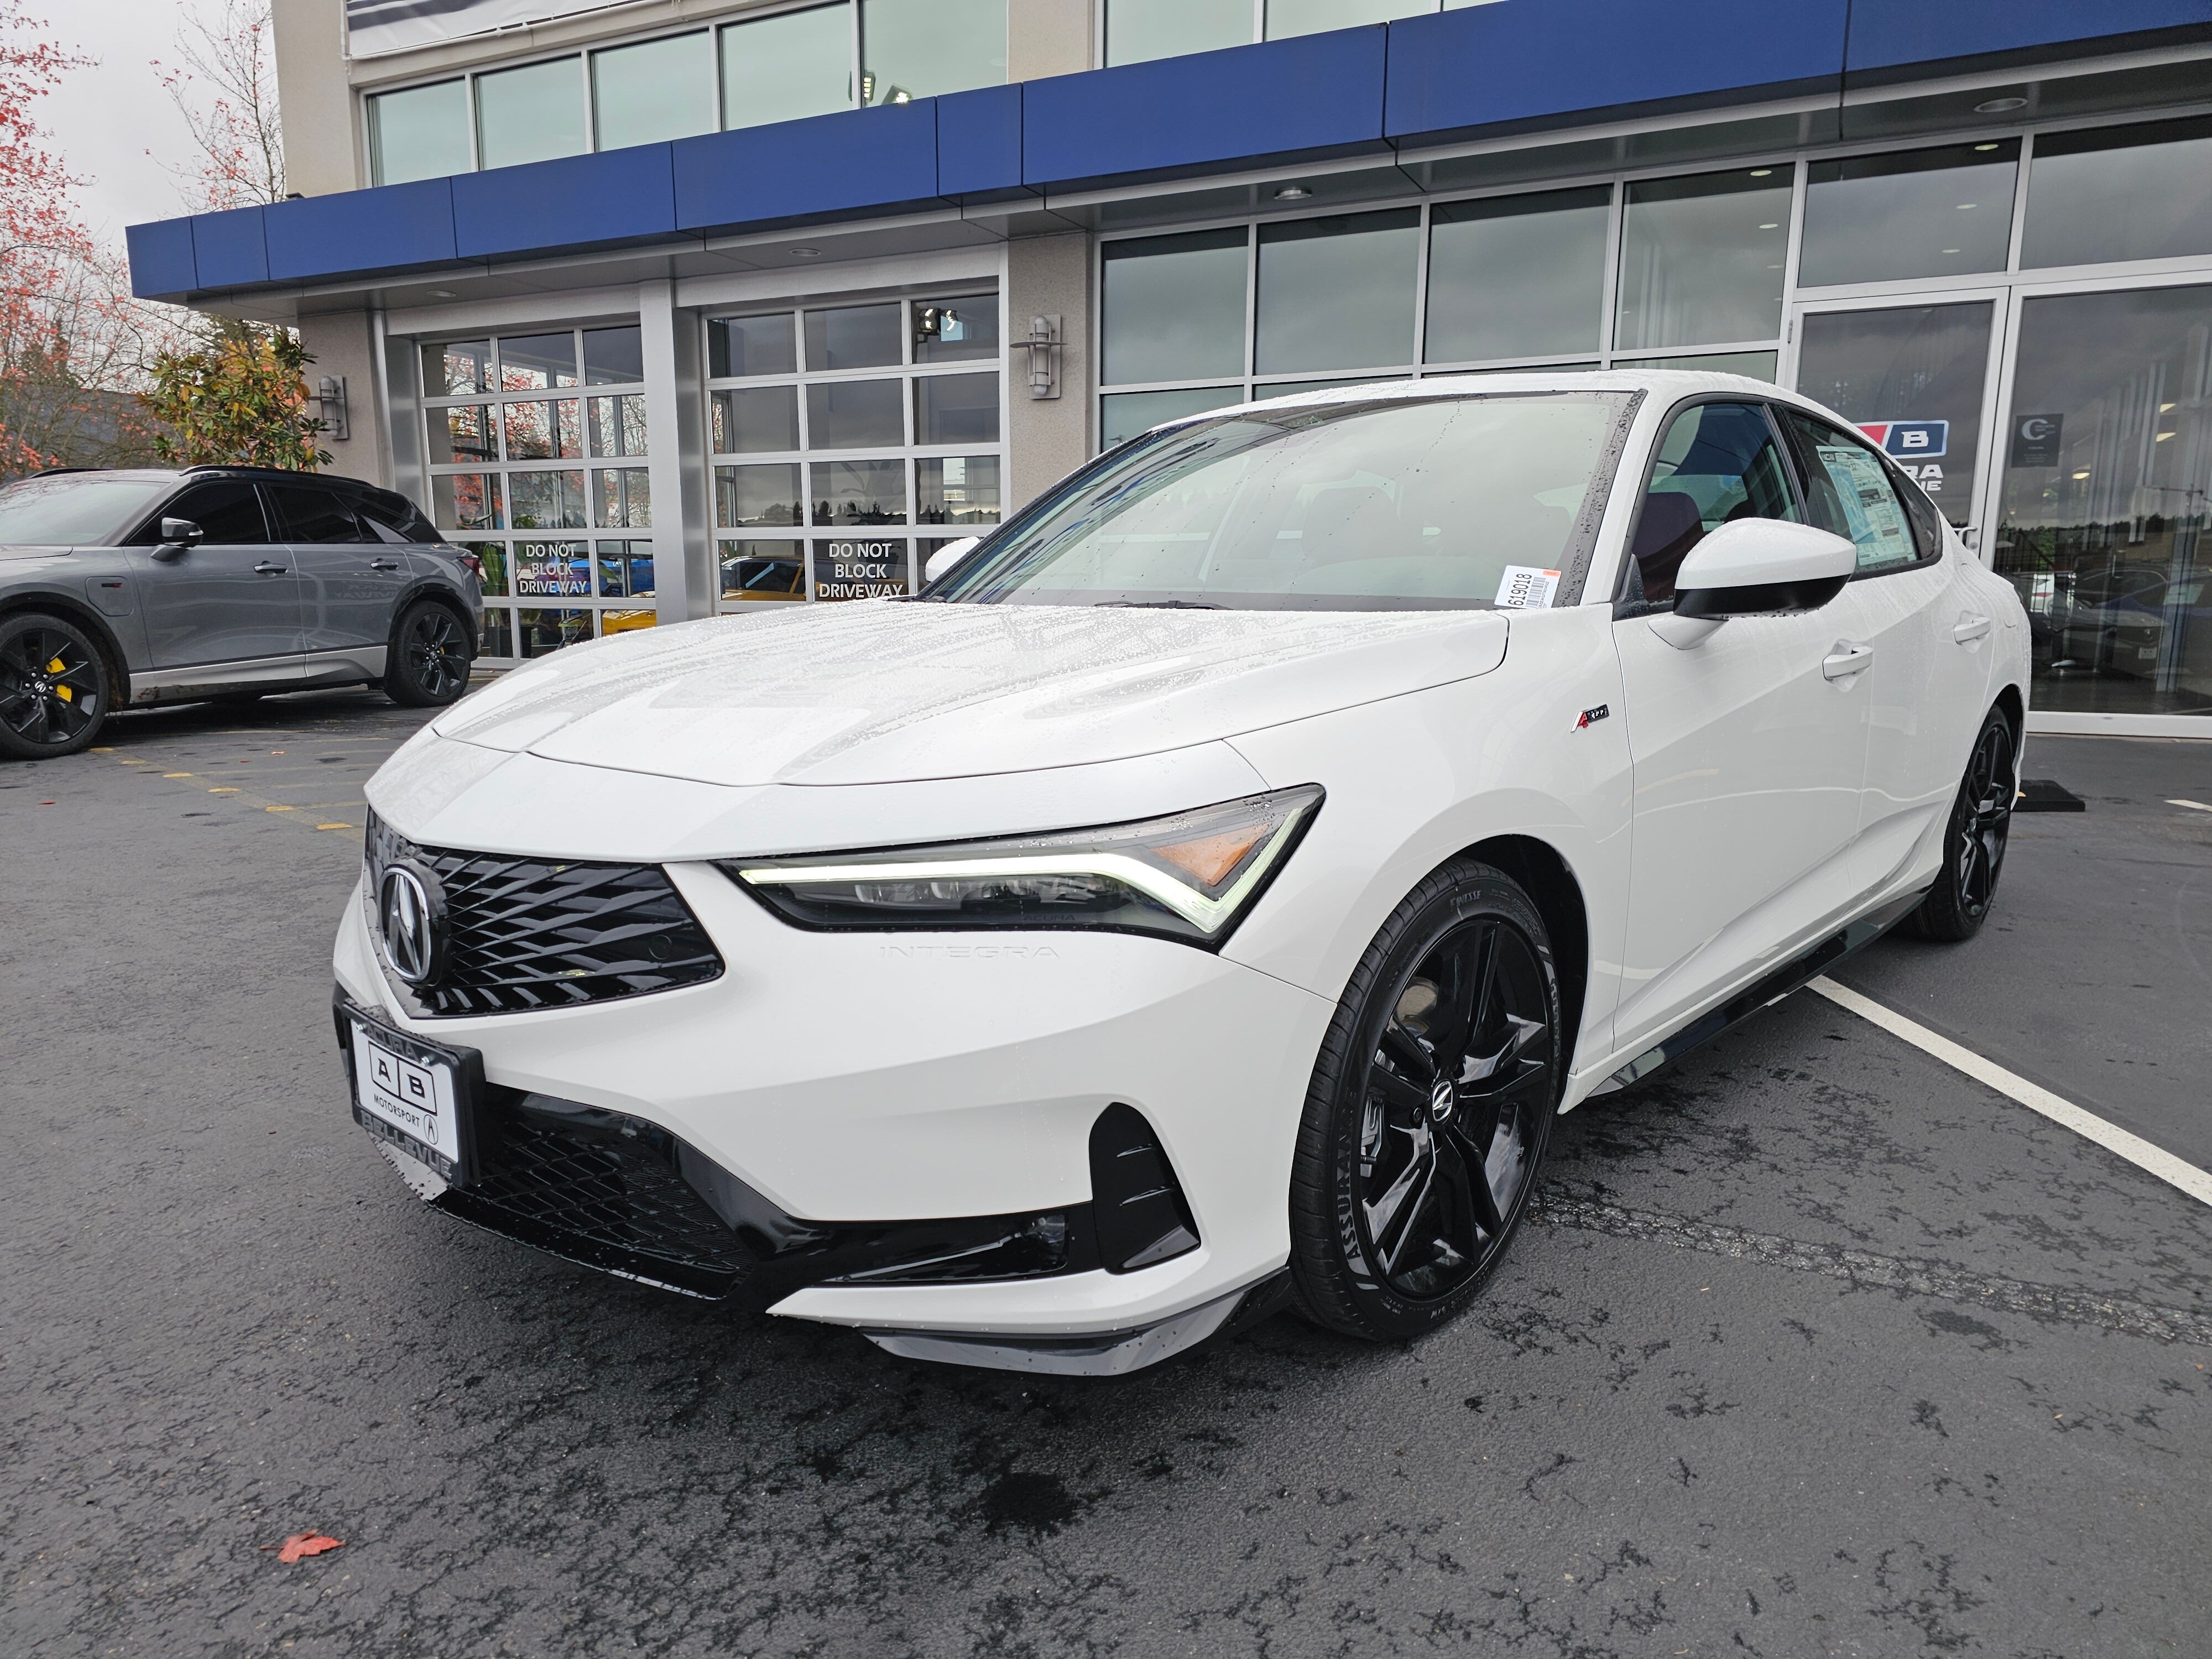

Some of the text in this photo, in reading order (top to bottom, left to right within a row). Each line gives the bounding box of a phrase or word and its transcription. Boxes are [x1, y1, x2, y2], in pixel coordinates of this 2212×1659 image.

[1901, 431, 1929, 447] B
[525, 544, 576, 557] DO NOT
[829, 543, 892, 558] DO NOT
[531, 562, 573, 575] BLOCK
[835, 564, 886, 578] BLOCK
[520, 581, 587, 593] DRIVEWAY
[819, 583, 903, 598] DRIVEWAY
[1507, 573, 1532, 606] 619018
[880, 946, 1060, 959] INTEGRA
[366, 1022, 421, 1063] ACURA
[378, 1057, 425, 1098] A B
[373, 1093, 420, 1128] MOTORSPORT
[361, 1109, 452, 1180] BELLEVUE
